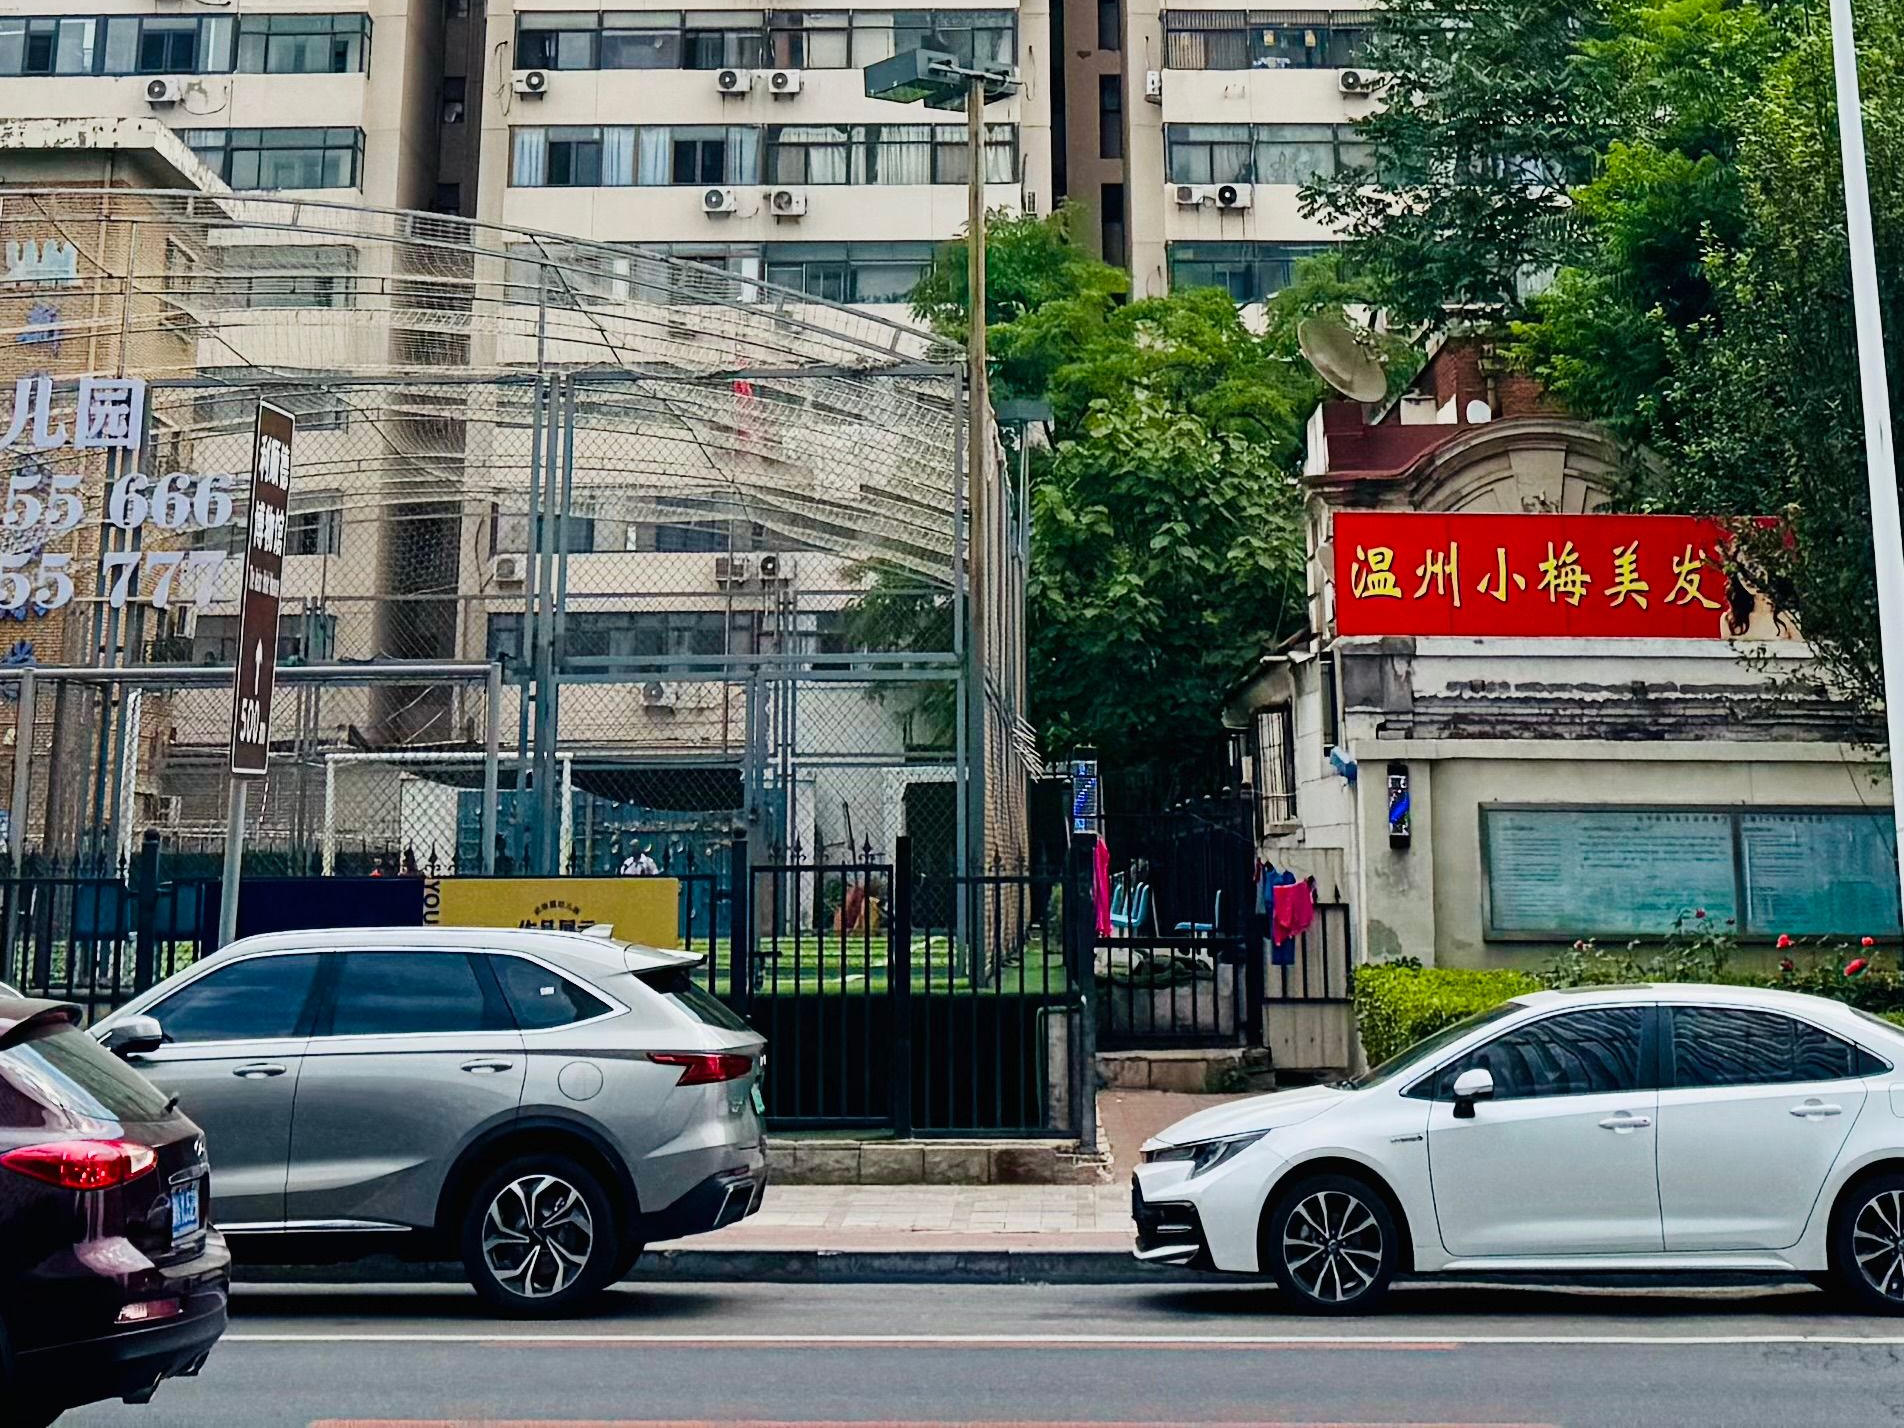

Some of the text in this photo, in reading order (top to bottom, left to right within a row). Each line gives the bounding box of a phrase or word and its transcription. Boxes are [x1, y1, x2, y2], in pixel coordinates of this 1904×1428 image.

[108, 471, 233, 530] 666
[102, 550, 227, 609] 777
[1350, 540, 1722, 611] 温州小梅美发
